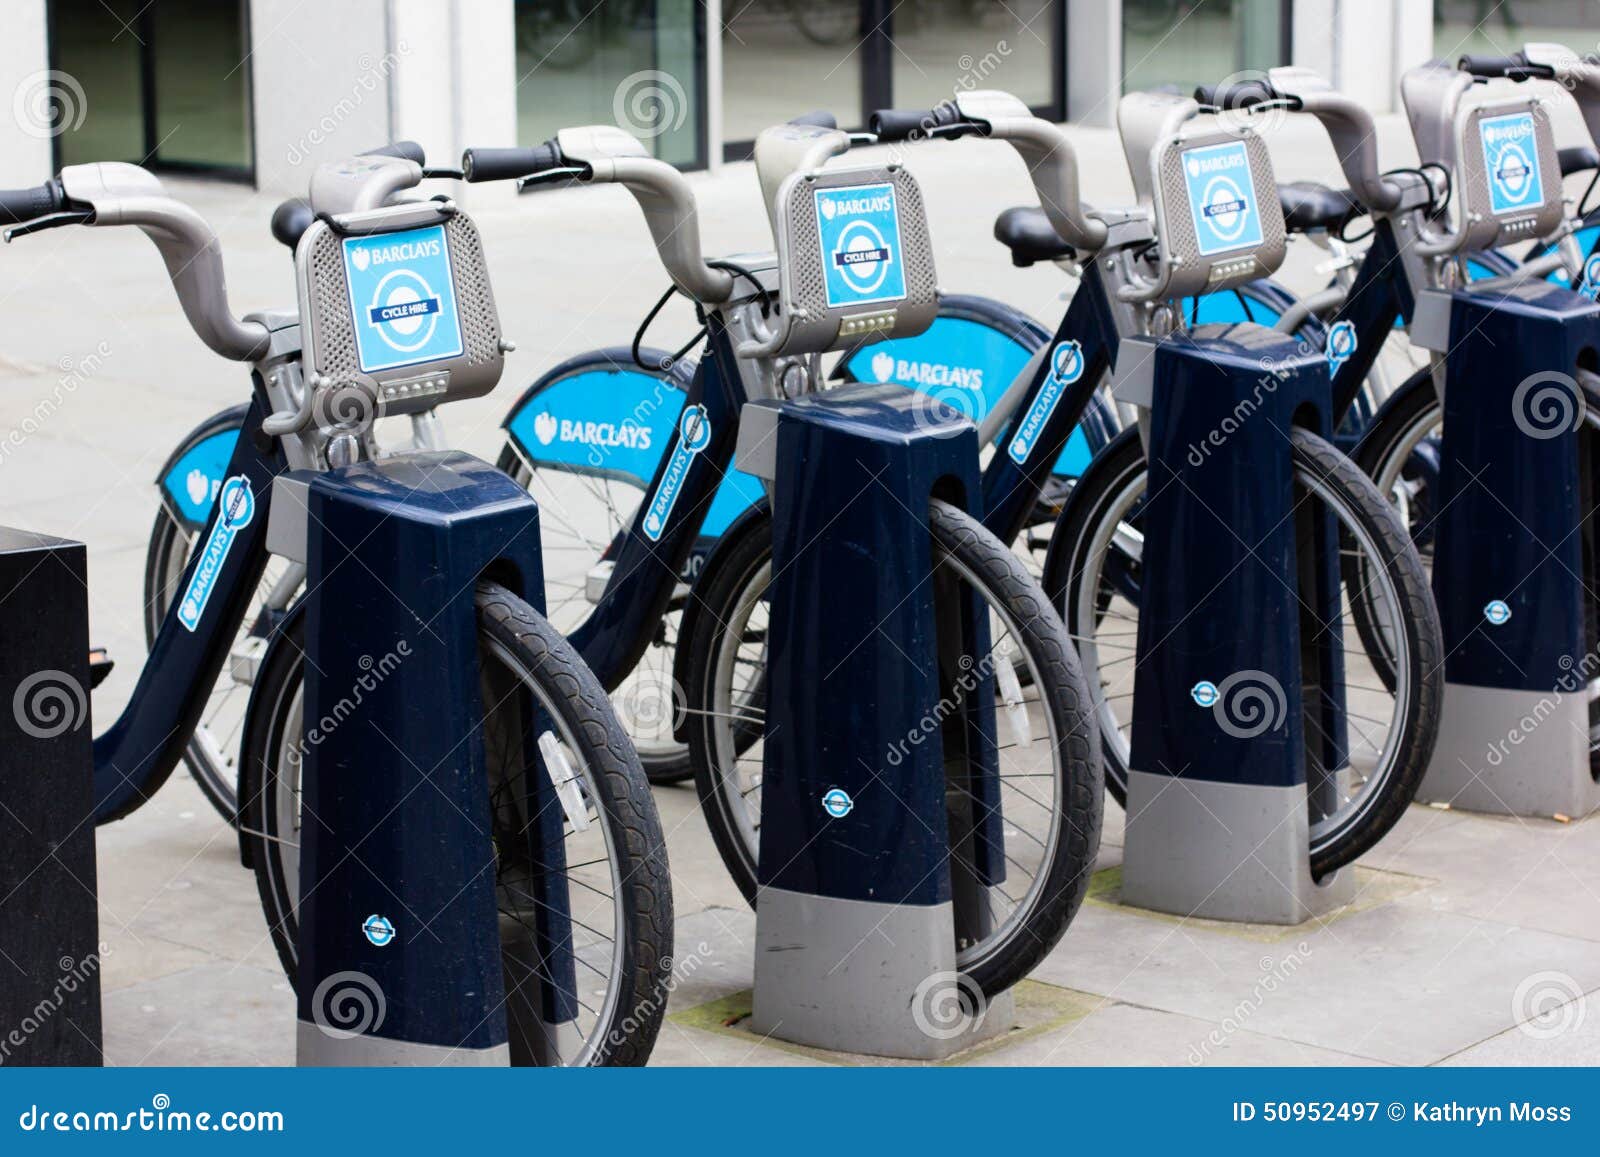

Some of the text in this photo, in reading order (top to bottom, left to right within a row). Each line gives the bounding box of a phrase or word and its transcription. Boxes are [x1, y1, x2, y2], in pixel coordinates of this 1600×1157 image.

[837, 196, 892, 216] BARCLAYS
[372, 240, 440, 265] BARCLAYS
[844, 252, 865, 263] CYCLE
[382, 302, 428, 319] CYCLE HIRE
[896, 360, 983, 391] BARCLAYS
[1023, 383, 1057, 441] BARCLAYS
[560, 419, 652, 450] BARCLAYS
[655, 453, 687, 516] BARCLAYS
[192, 530, 227, 604] BARCLAYS
